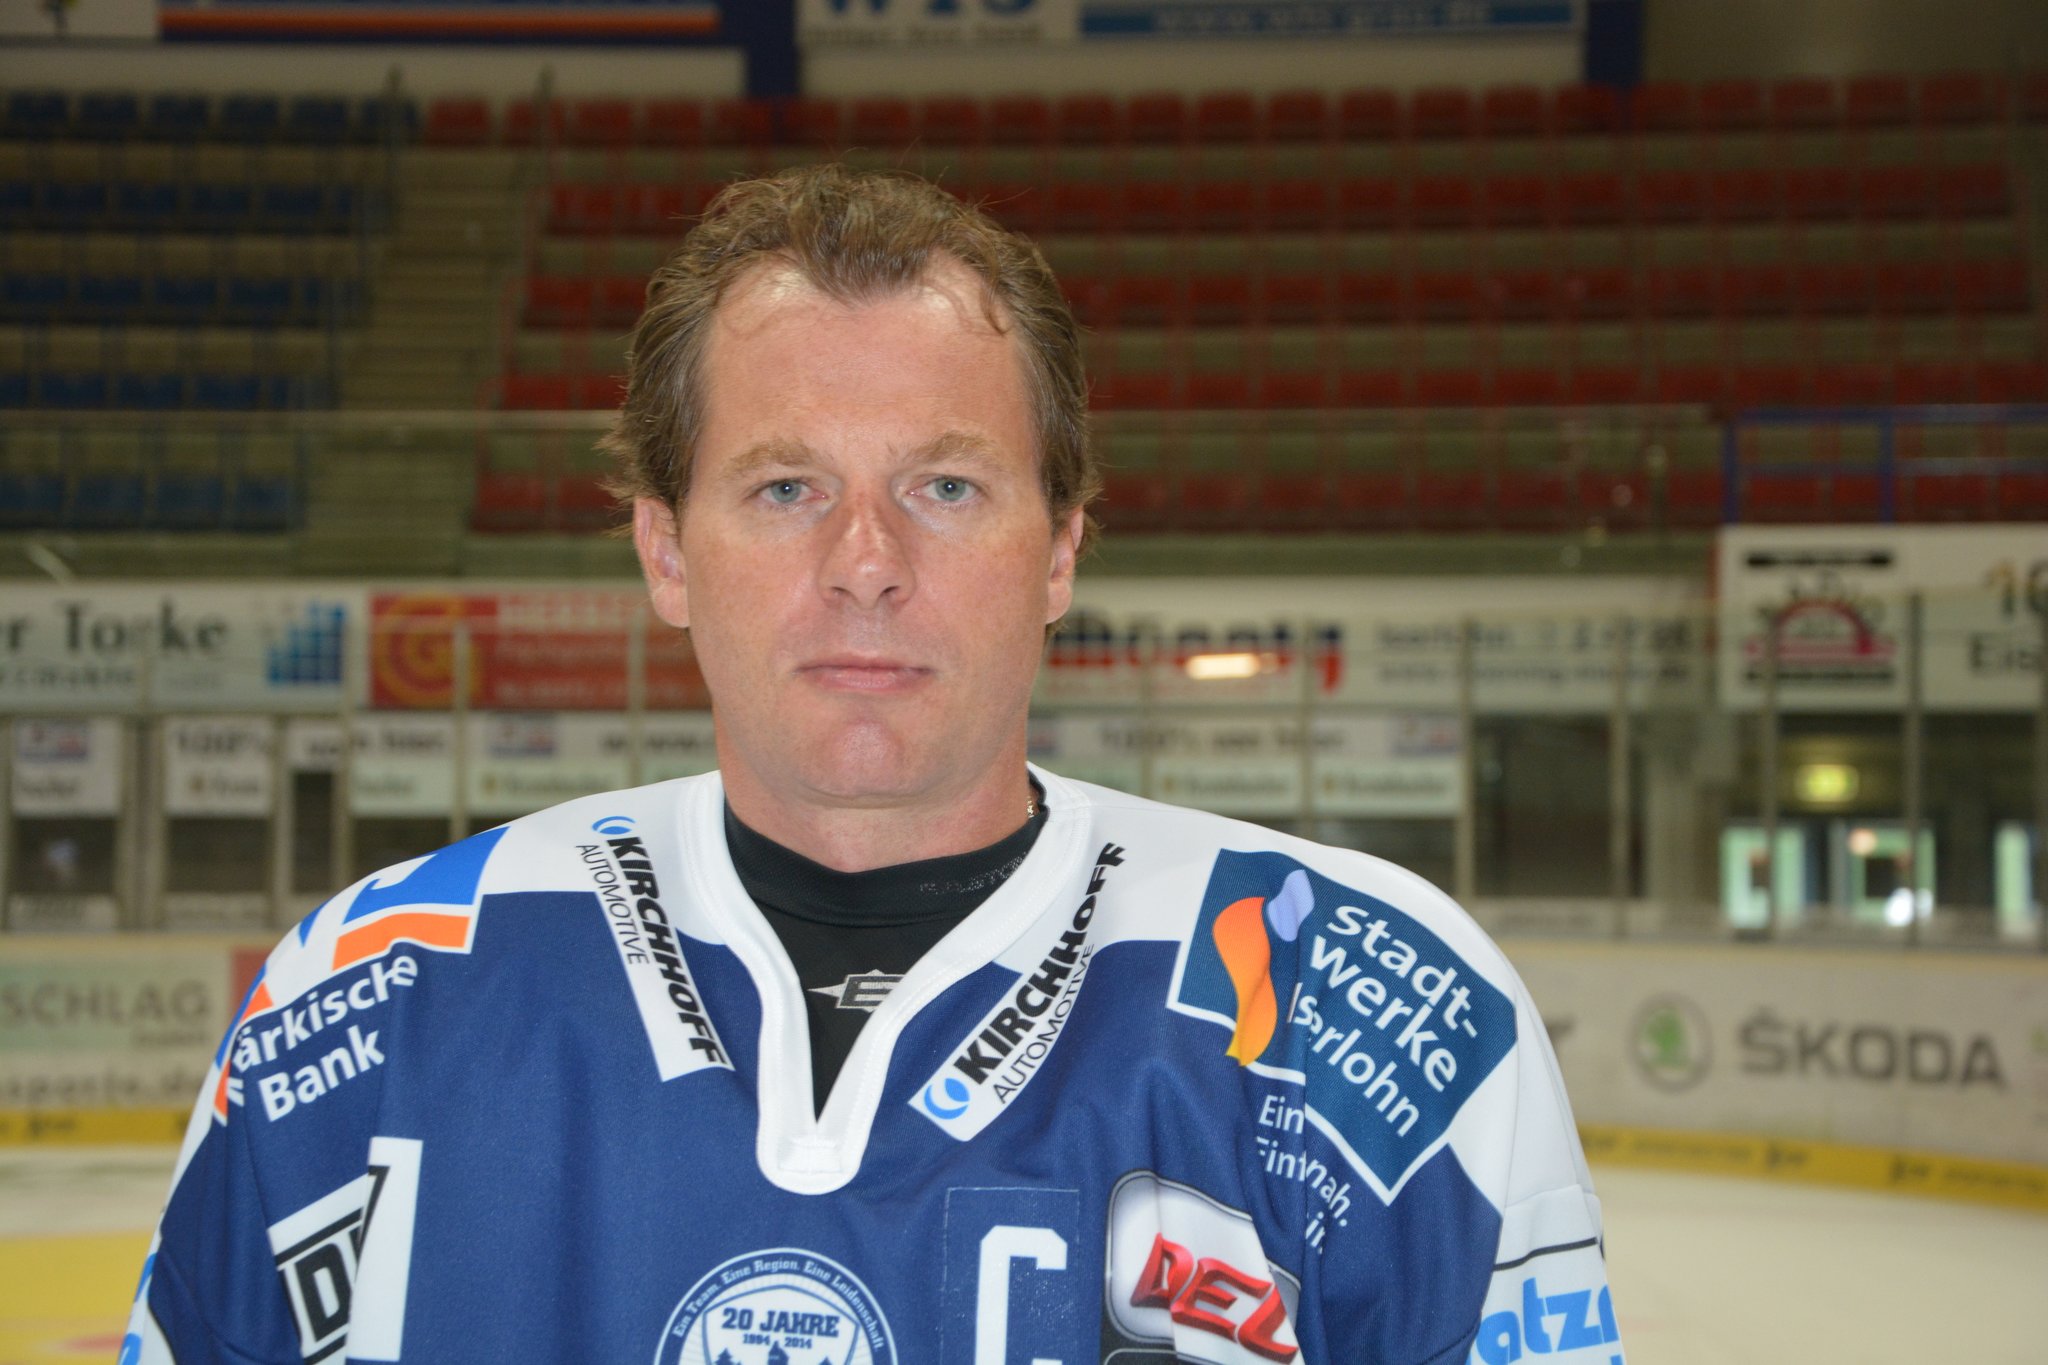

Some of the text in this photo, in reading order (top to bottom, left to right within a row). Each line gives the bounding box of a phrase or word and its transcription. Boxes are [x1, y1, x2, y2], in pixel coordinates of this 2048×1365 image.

[576, 844, 650, 966] AUTOMOTIVE
[606, 836, 728, 1065] KIRCHHOFF
[953, 842, 1126, 1086] KIRCHHOFF
[1309, 934, 1458, 1093] werke
[258, 1024, 386, 1123] Bank
[992, 943, 1094, 1104] AUTOMOTIVE
[1738, 1006, 2009, 1089] ŠKODA
[1258, 1094, 1305, 1134] Ein
[672, 1314, 692, 1339] Ein
[687, 1284, 720, 1314] Team.
[721, 1267, 752, 1285] Eine
[753, 1258, 800, 1274] Region.
[803, 1260, 832, 1283] Eine
[721, 1306, 840, 1339] 20 JAHRE
[743, 1333, 813, 1350] 1994 2014
[974, 1225, 1068, 1365] C
[1130, 1231, 1300, 1365] DEL
[1465, 1276, 1620, 1365] atz
